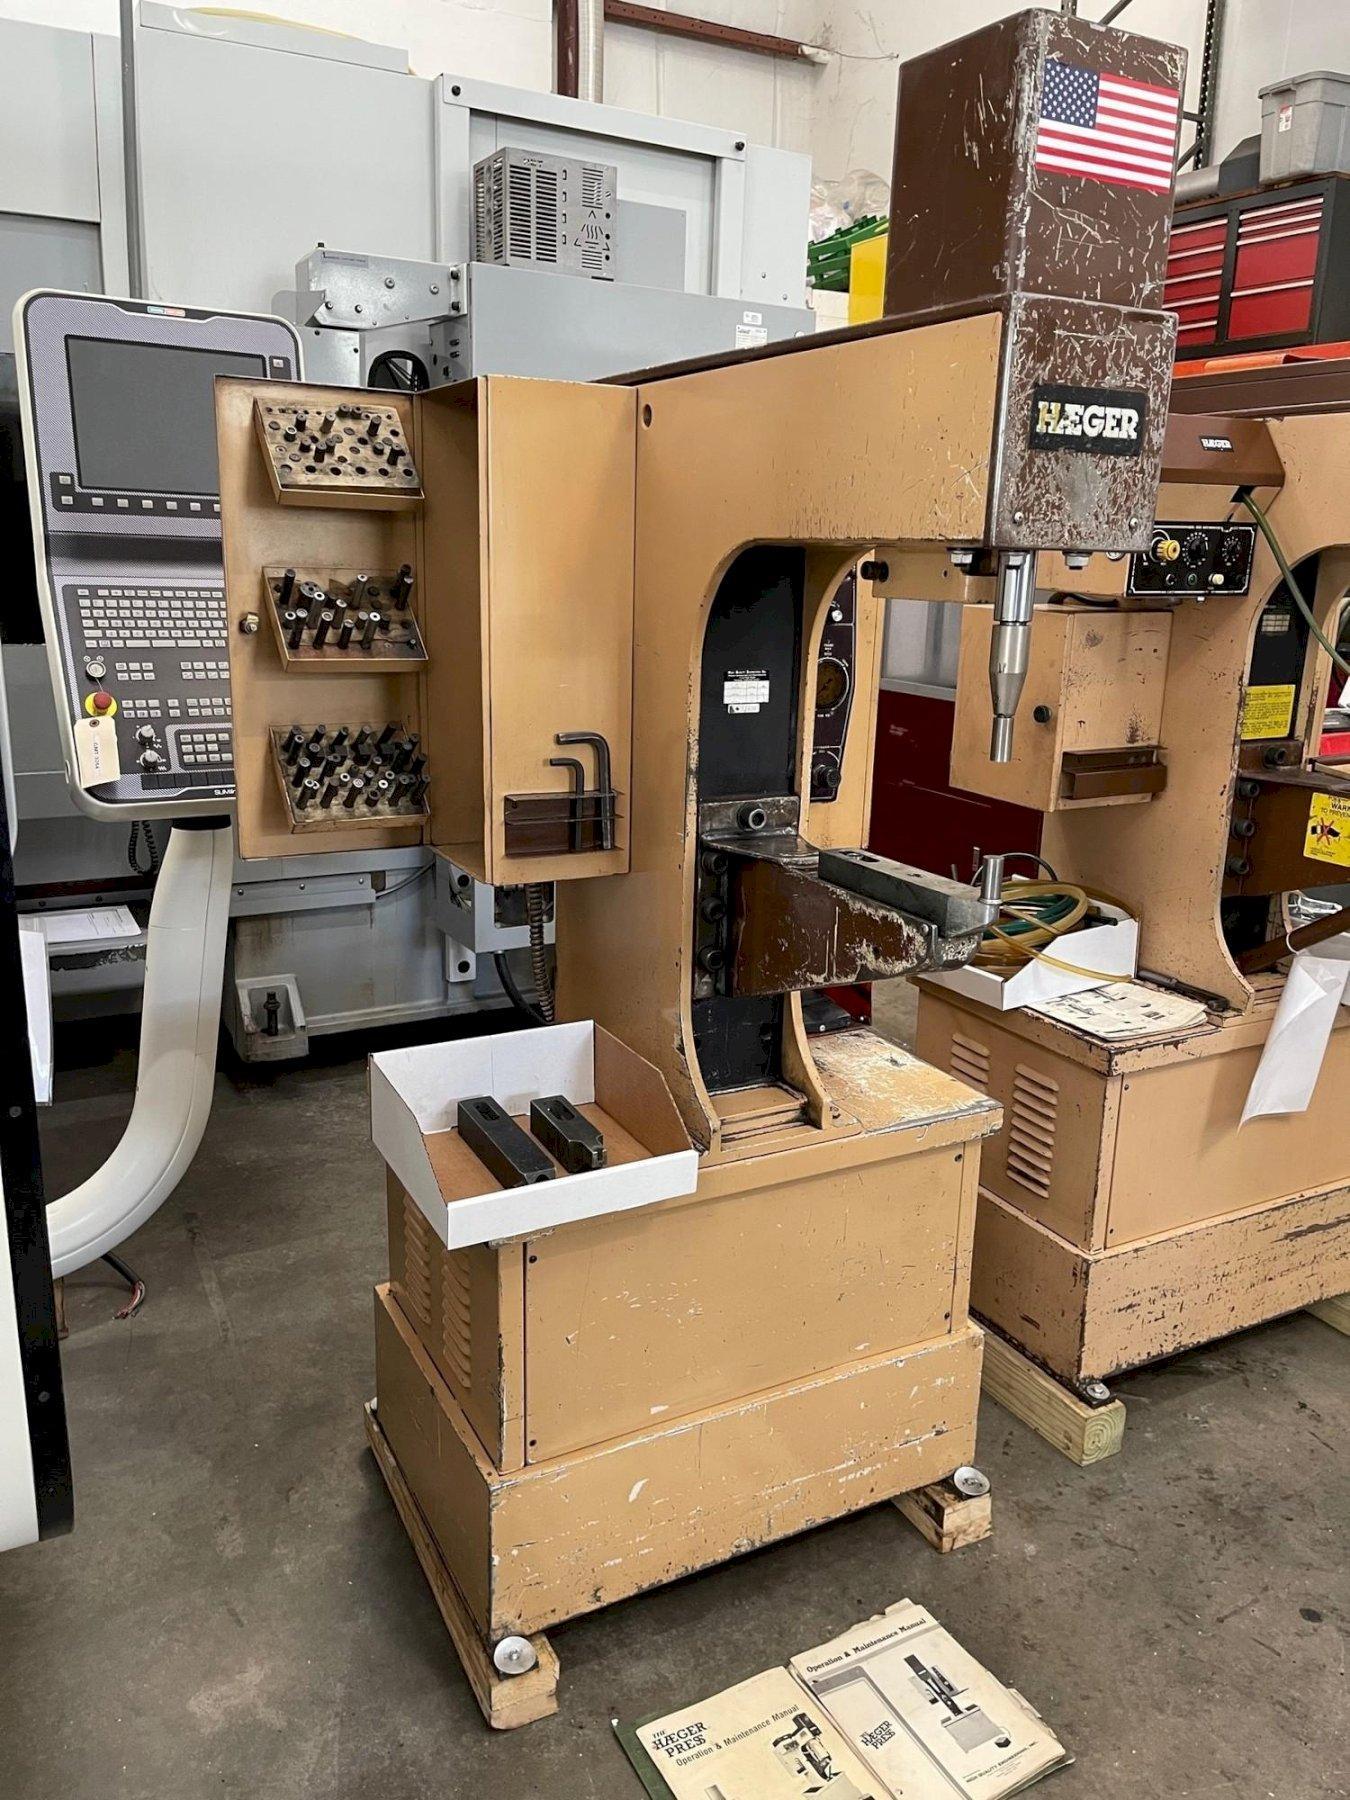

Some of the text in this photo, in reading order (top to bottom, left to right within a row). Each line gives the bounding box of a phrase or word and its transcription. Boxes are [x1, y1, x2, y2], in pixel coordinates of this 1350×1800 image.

[806, 1655, 843, 1673] Operation
[852, 1630, 898, 1653] Maintenance
[898, 1618, 926, 1633] Manual
[665, 1734, 706, 1757] PRESS
[676, 1704, 799, 1767] Operation & Maintenance Manual
[871, 1729, 896, 1749] PRESS
